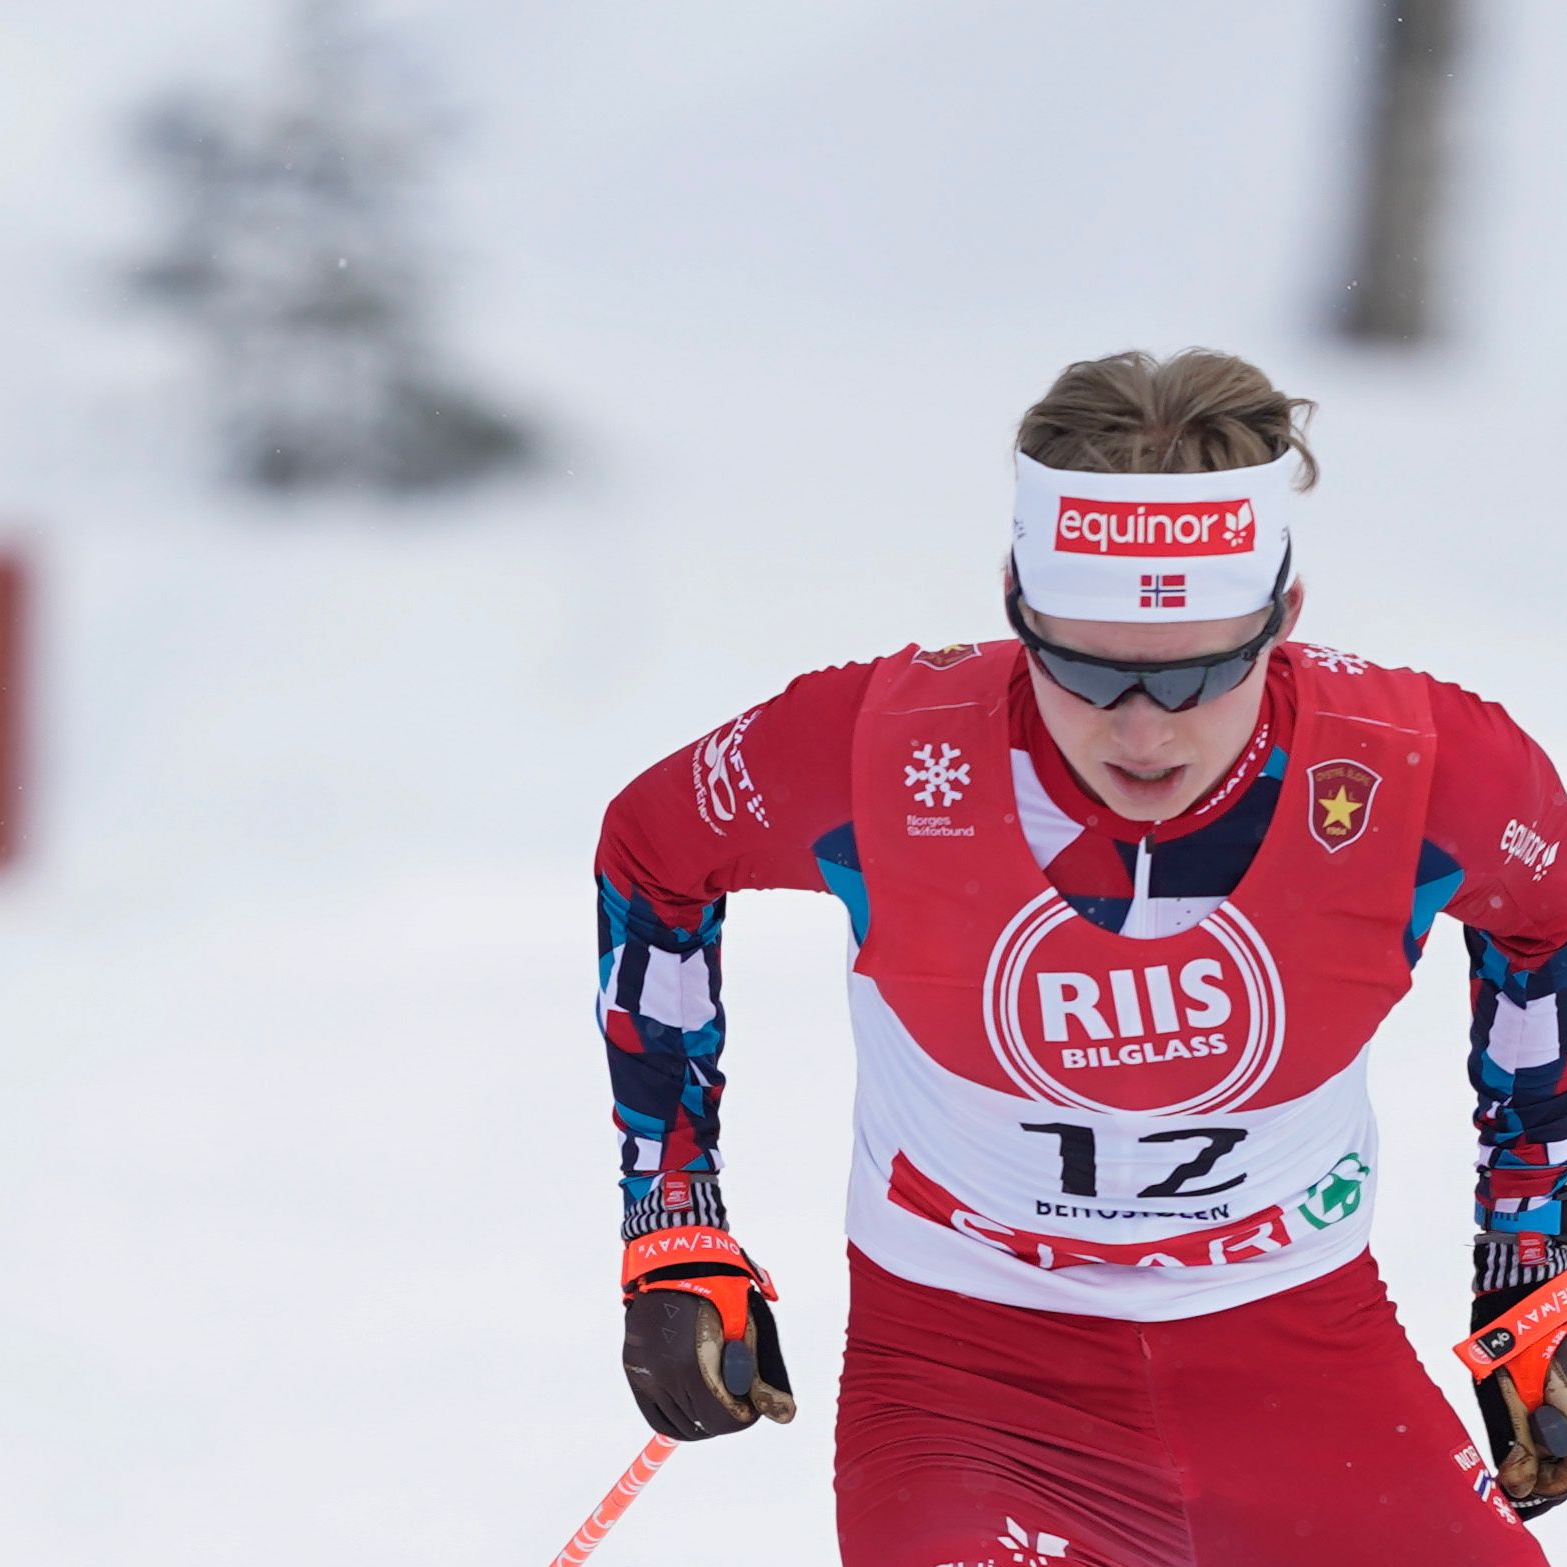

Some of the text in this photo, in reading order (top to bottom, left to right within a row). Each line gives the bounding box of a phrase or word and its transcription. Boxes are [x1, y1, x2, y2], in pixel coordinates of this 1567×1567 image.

[1059, 506, 1219, 552] equinor
[907, 815, 951, 827] Norges
[907, 825, 975, 837] Skiforbund
[1036, 958, 1232, 1042] RIIS
[1062, 1033, 1228, 1069] BILGLASS
[1019, 1122, 1249, 1198] 12
[645, 1232, 741, 1258] ONE/WAY
